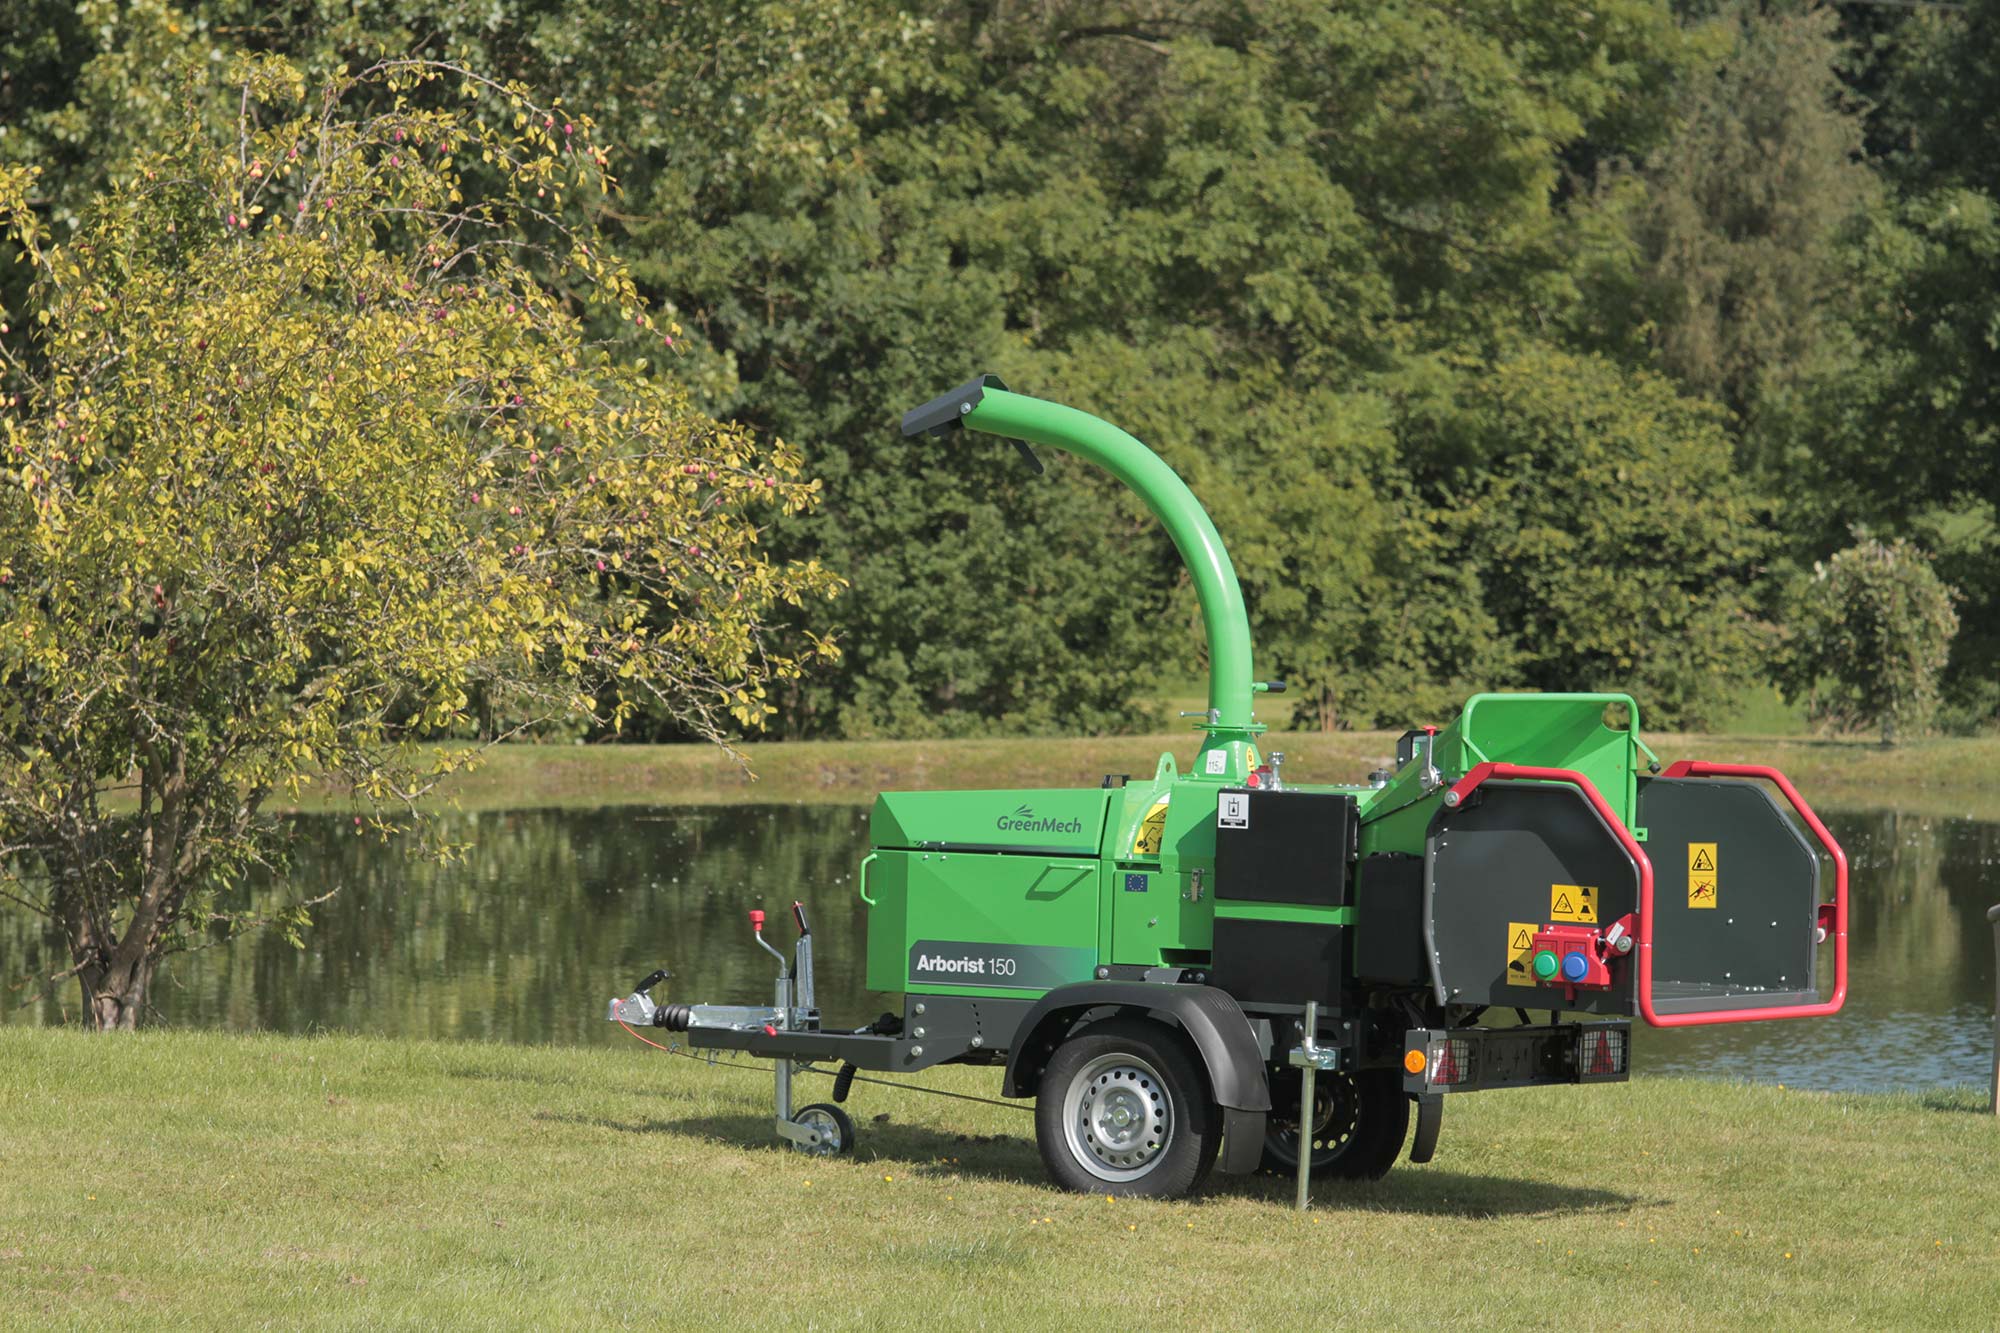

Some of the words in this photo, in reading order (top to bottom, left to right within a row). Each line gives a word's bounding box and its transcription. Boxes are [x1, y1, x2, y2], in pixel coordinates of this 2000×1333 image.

[996, 815, 1082, 833] GreenMech
[916, 954, 984, 974] Arborist
[988, 958, 1016, 976] 150
